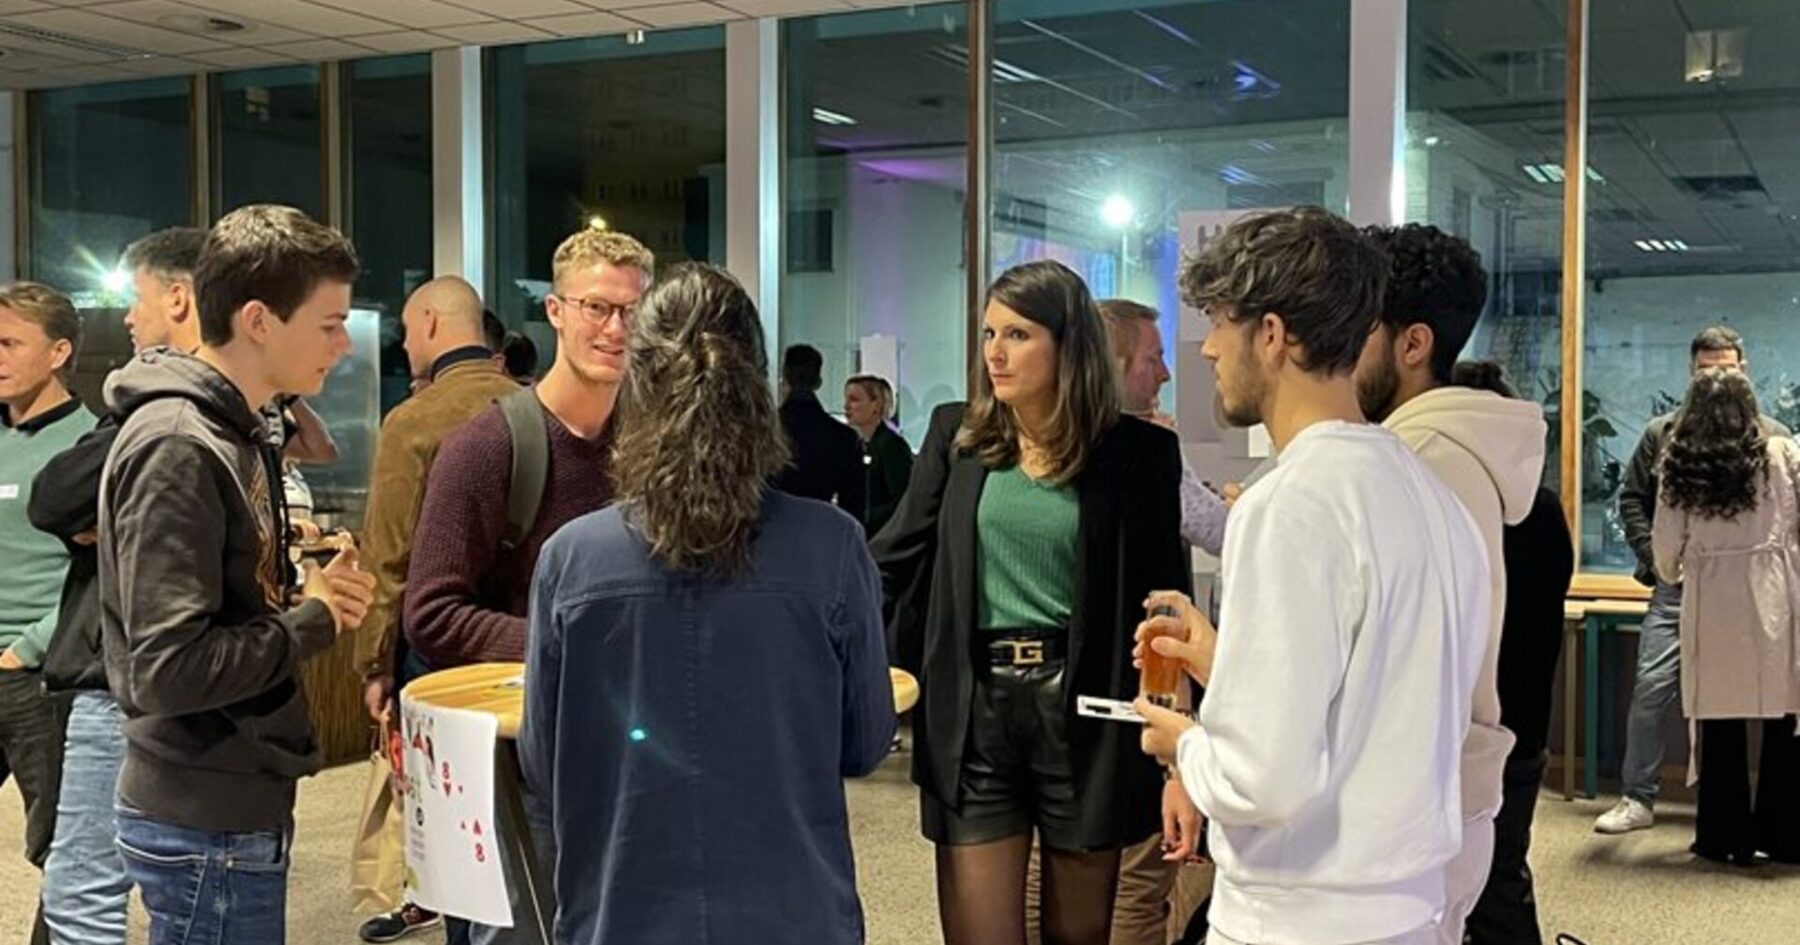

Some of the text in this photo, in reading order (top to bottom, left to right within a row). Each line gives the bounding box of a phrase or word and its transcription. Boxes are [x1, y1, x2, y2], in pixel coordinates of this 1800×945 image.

[1013, 640, 1044, 664] G
[442, 761, 450, 780] 8
[475, 842, 486, 863] 8
